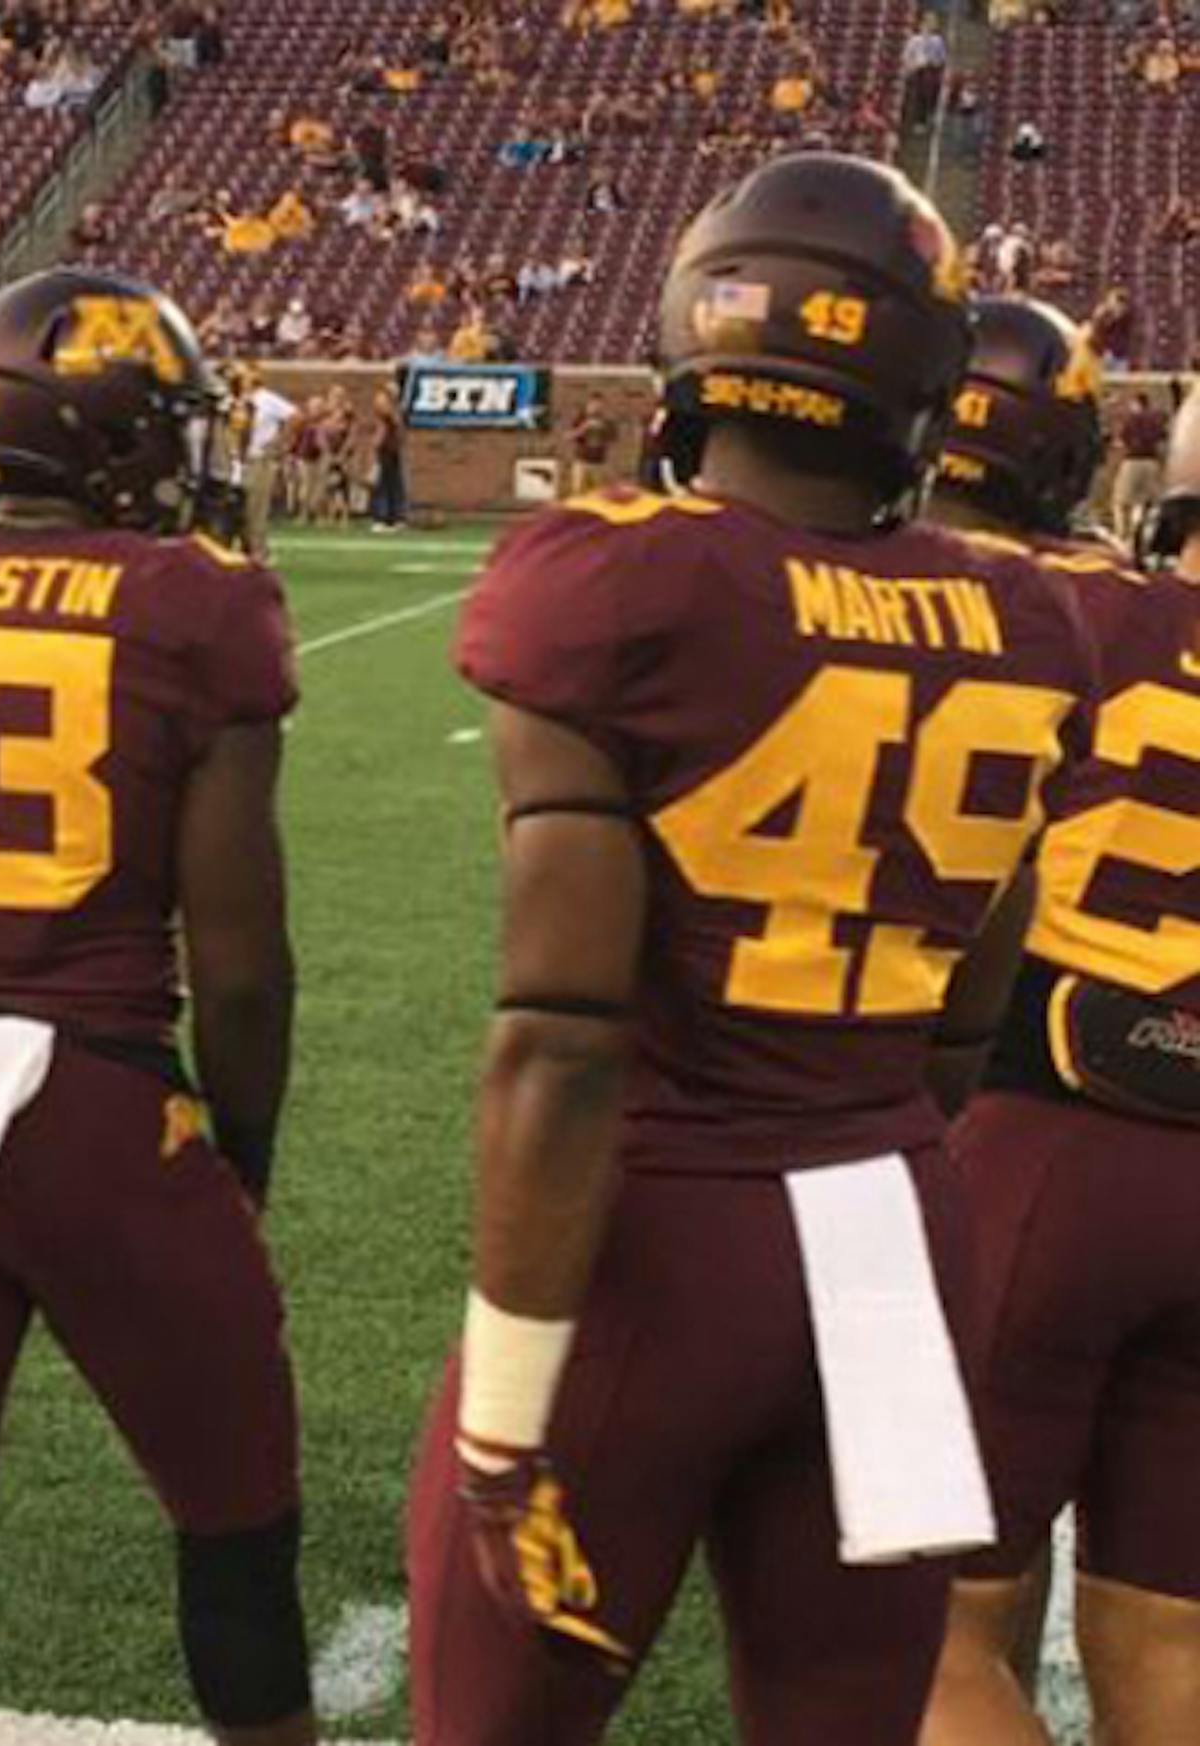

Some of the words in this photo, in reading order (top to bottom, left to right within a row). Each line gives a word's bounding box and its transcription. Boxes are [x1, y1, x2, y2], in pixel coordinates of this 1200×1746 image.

[800, 289, 868, 344] 49
[412, 376, 519, 413] BTN
[785, 557, 1003, 656] MARTIN
[648, 663, 1078, 1017] 49
